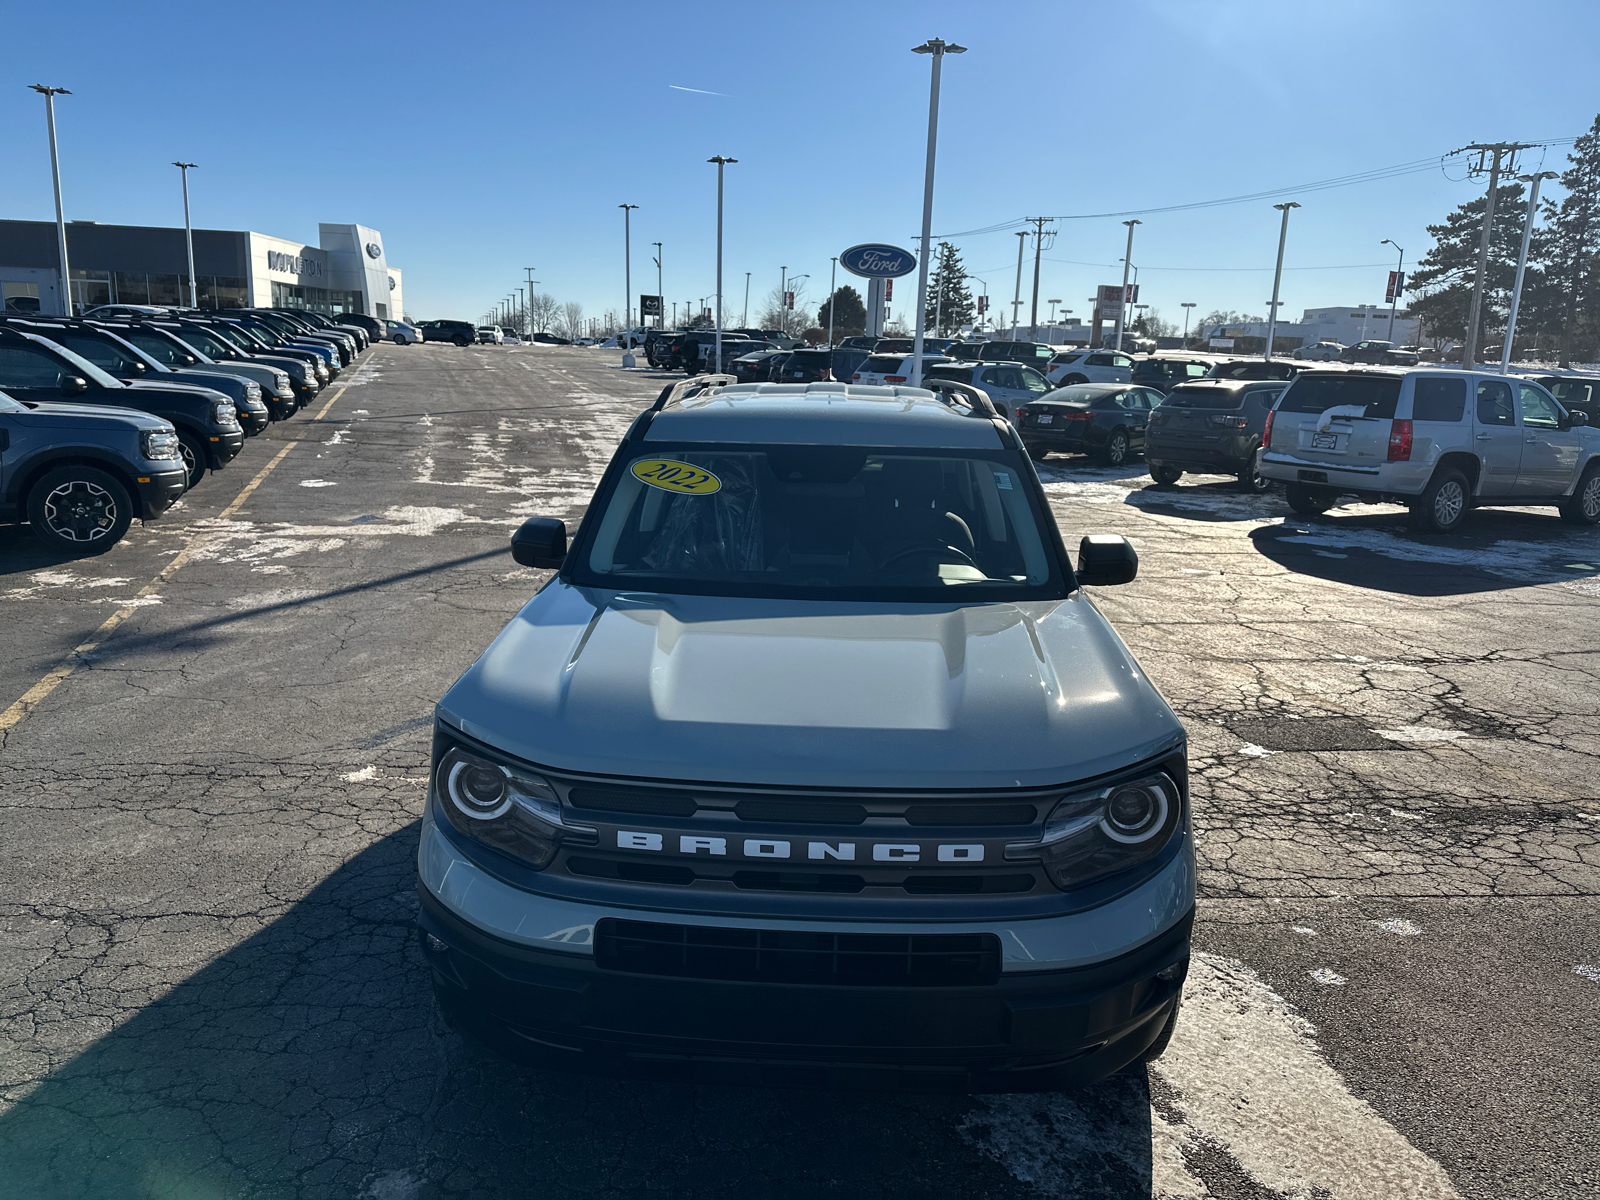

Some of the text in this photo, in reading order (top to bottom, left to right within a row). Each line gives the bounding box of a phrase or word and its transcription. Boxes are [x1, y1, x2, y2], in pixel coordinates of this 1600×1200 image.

[267, 250, 322, 277] MAPLETON
[858, 250, 902, 272] Ford
[640, 463, 710, 489] 2022
[617, 830, 985, 862] BRONCO
